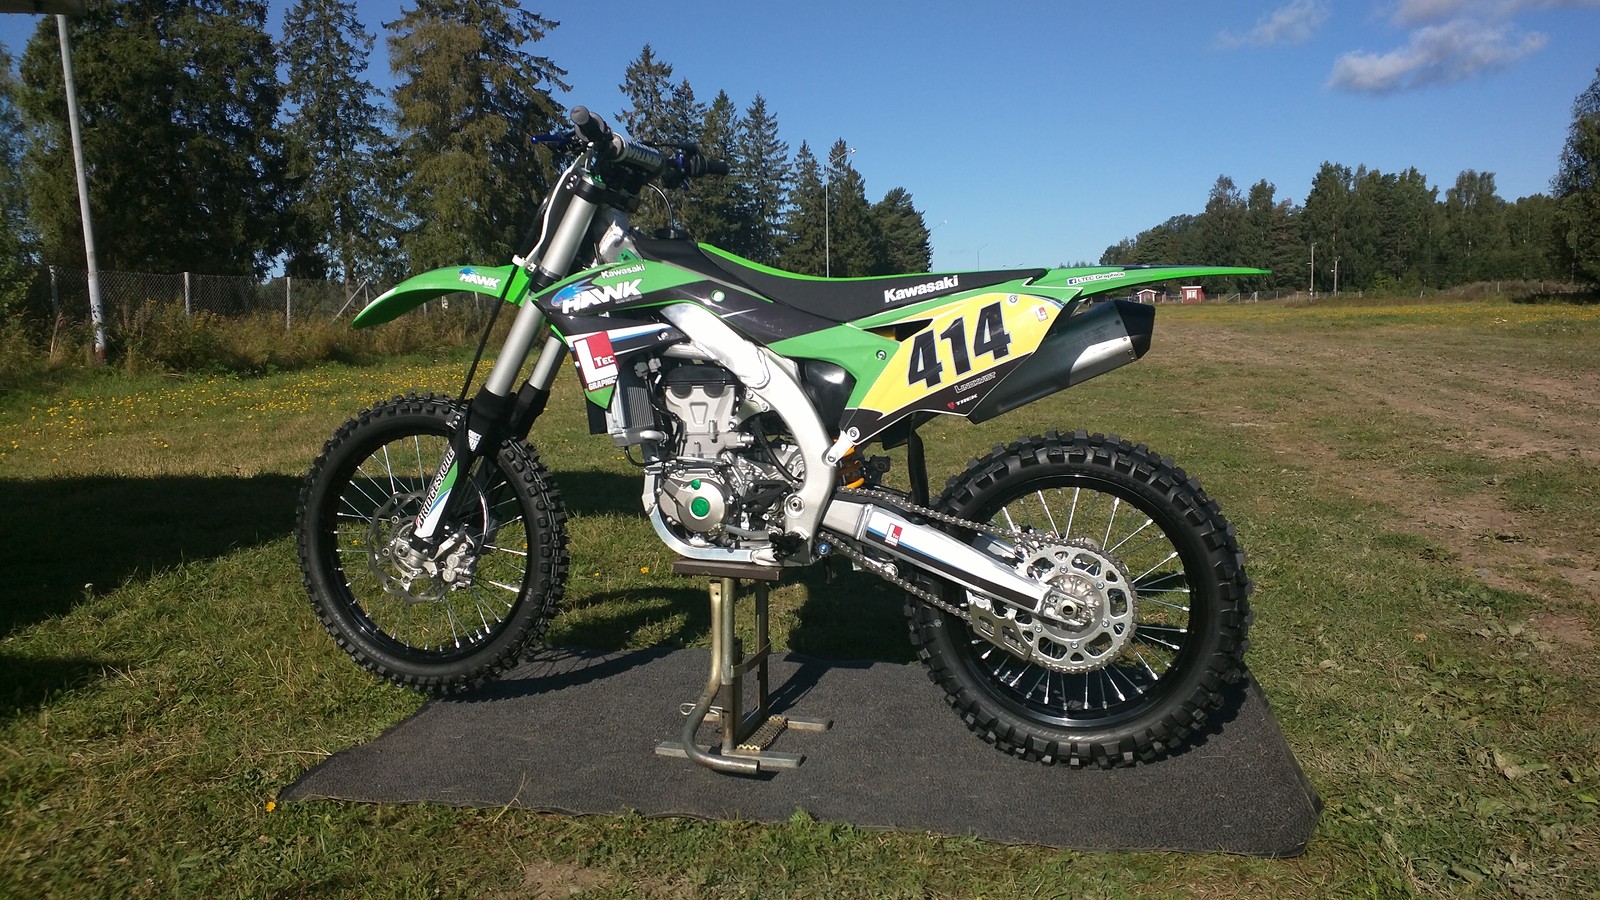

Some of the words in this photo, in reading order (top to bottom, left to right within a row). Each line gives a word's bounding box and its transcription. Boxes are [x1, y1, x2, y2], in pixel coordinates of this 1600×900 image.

[458, 273, 502, 288] HAWK
[600, 264, 646, 279] Kawasaki
[562, 278, 643, 314] HAWK
[884, 275, 959, 303] Kawasaki
[907, 300, 1011, 389] 414
[955, 393, 978, 406] TREK
[416, 446, 456, 529] BRIDGESTONE
